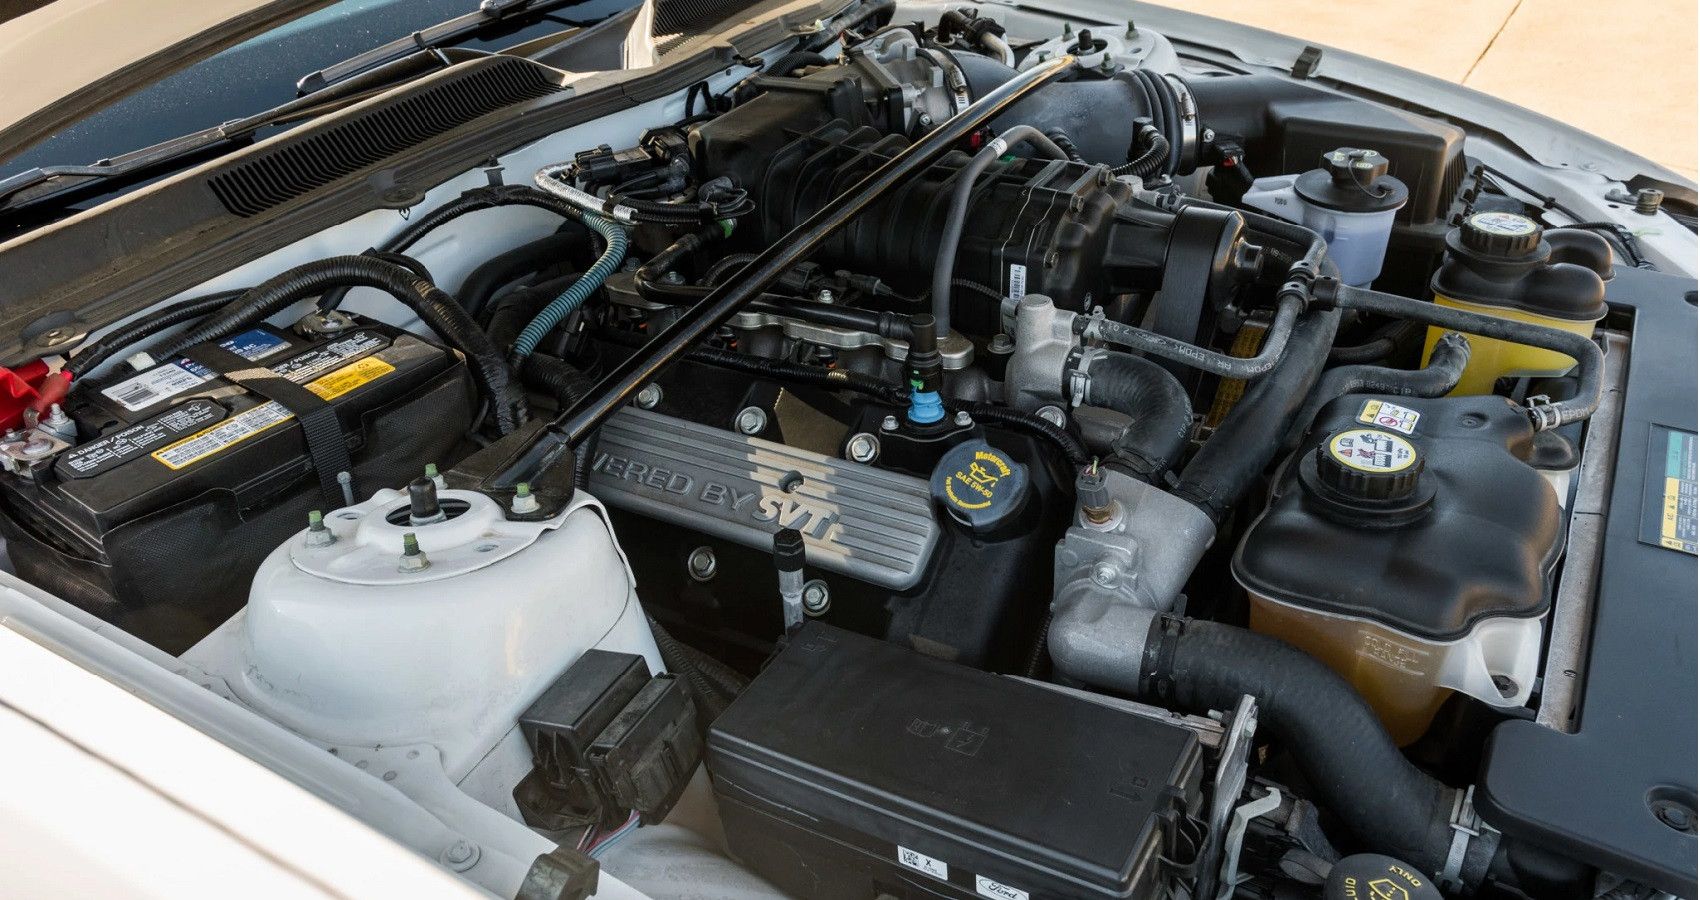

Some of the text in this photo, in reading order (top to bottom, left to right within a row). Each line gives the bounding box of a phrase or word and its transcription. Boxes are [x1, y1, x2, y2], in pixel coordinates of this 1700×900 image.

[78, 440, 111, 455] DANGER
[116, 424, 145, 439] POISON
[975, 451, 1011, 478] Motorcraft
[955, 471, 973, 485] SAE
[970, 482, 993, 498] 5W-50
[700, 481, 757, 512] BY
[751, 495, 836, 537] SVT
[988, 881, 1018, 899] Ford
[1345, 877, 1358, 900] UID
[1388, 865, 1422, 888] ONLY
